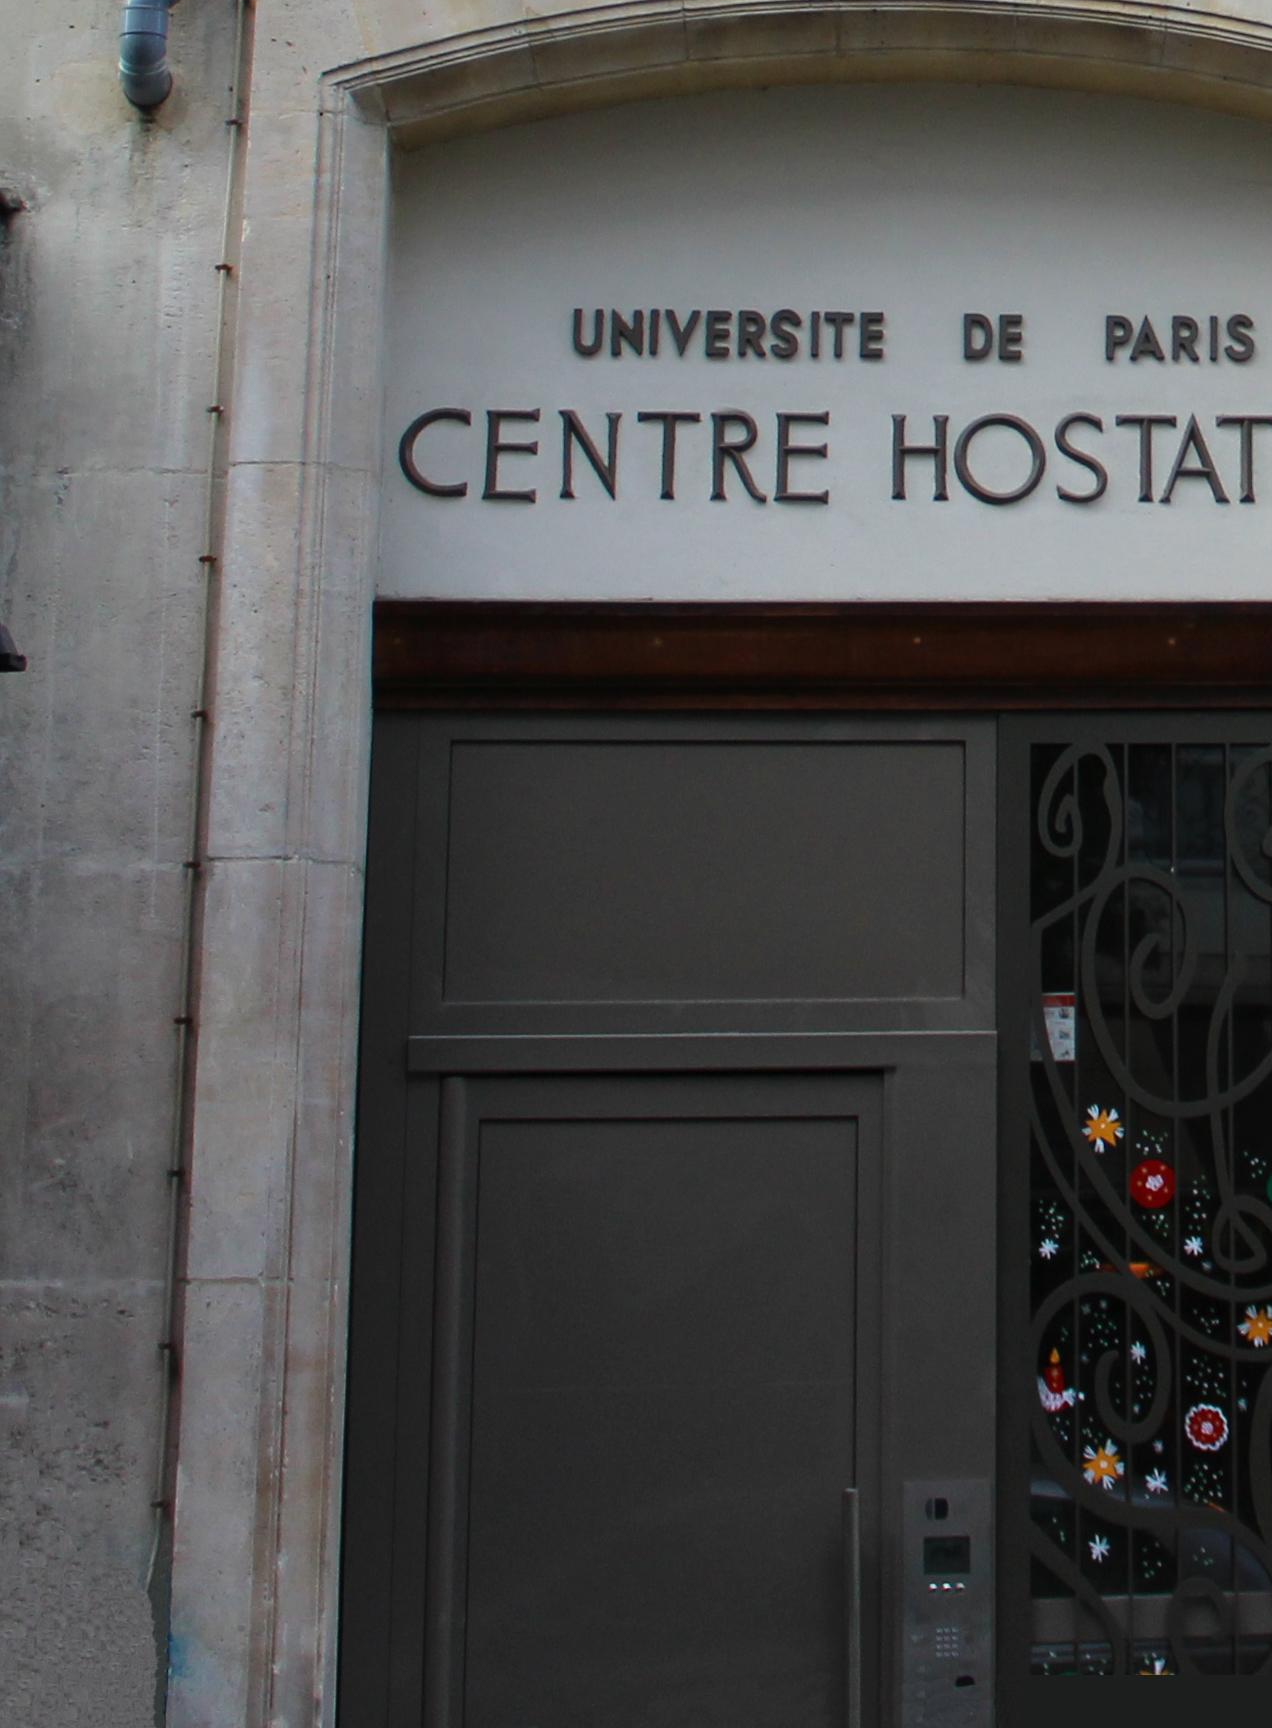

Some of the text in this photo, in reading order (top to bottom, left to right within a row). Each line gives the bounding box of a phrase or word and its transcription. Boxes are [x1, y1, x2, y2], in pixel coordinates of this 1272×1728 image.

[571, 308, 1255, 365] UNIVERSITE DE PARIS
[399, 408, 830, 506] CENTRE
